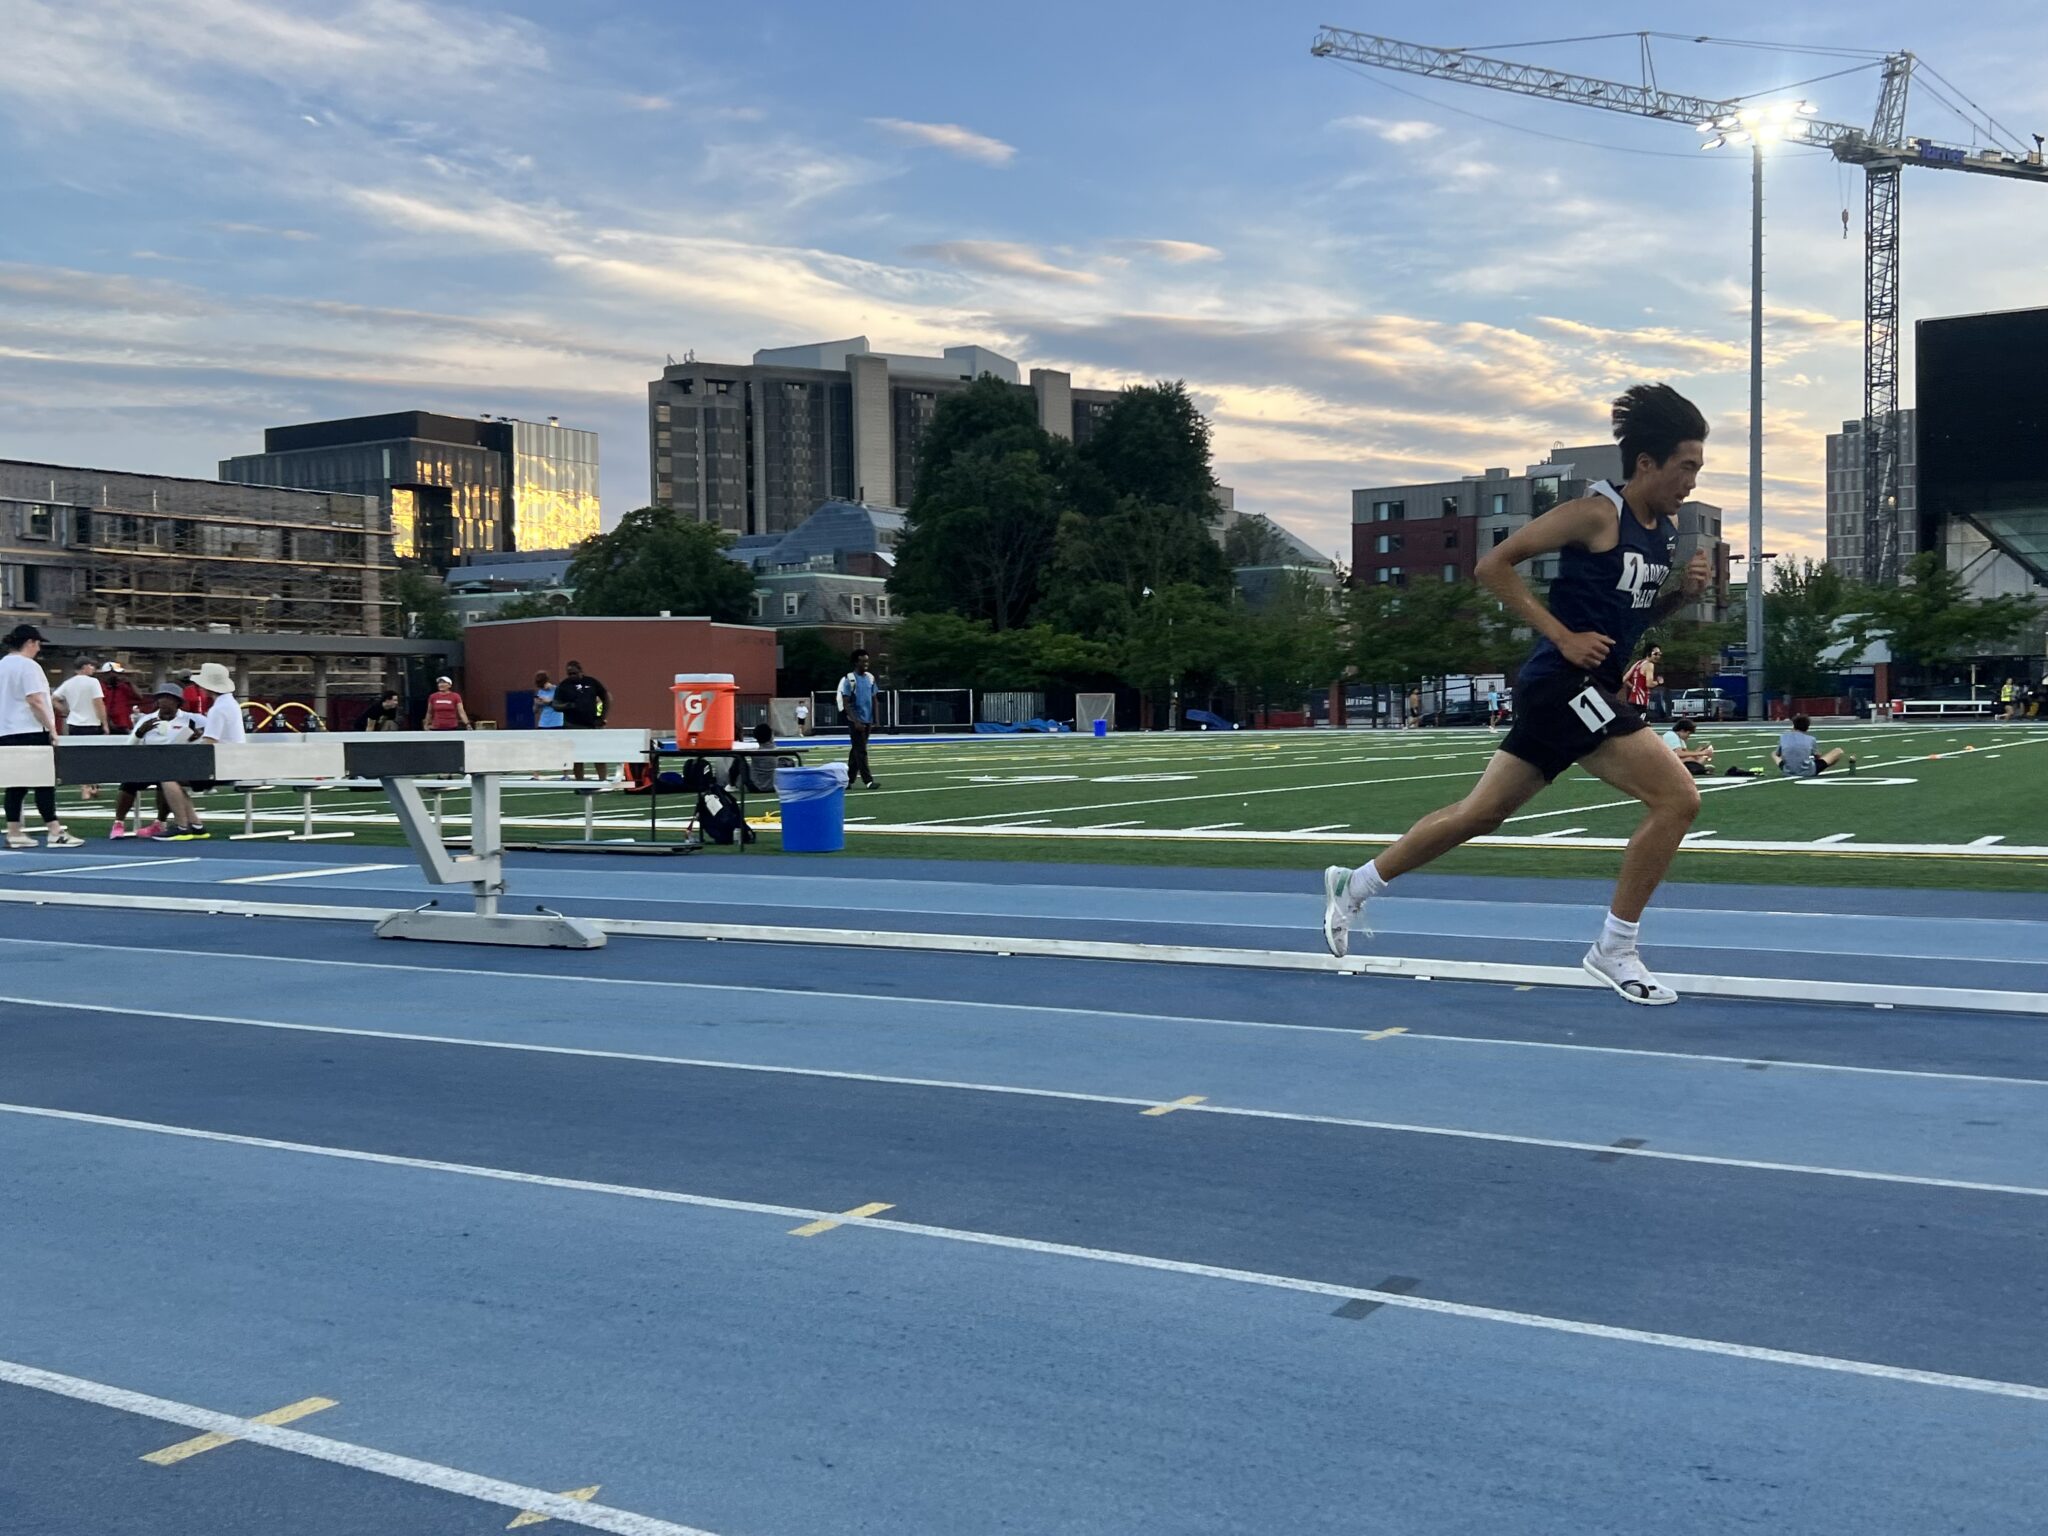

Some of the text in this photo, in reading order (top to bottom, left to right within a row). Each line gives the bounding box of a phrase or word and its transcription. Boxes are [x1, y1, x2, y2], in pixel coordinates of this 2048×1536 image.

[1629, 556, 1638, 589] 1
[1643, 563, 1670, 586] RONTO
[685, 694, 703, 715] G
[1580, 694, 1606, 724] 1
